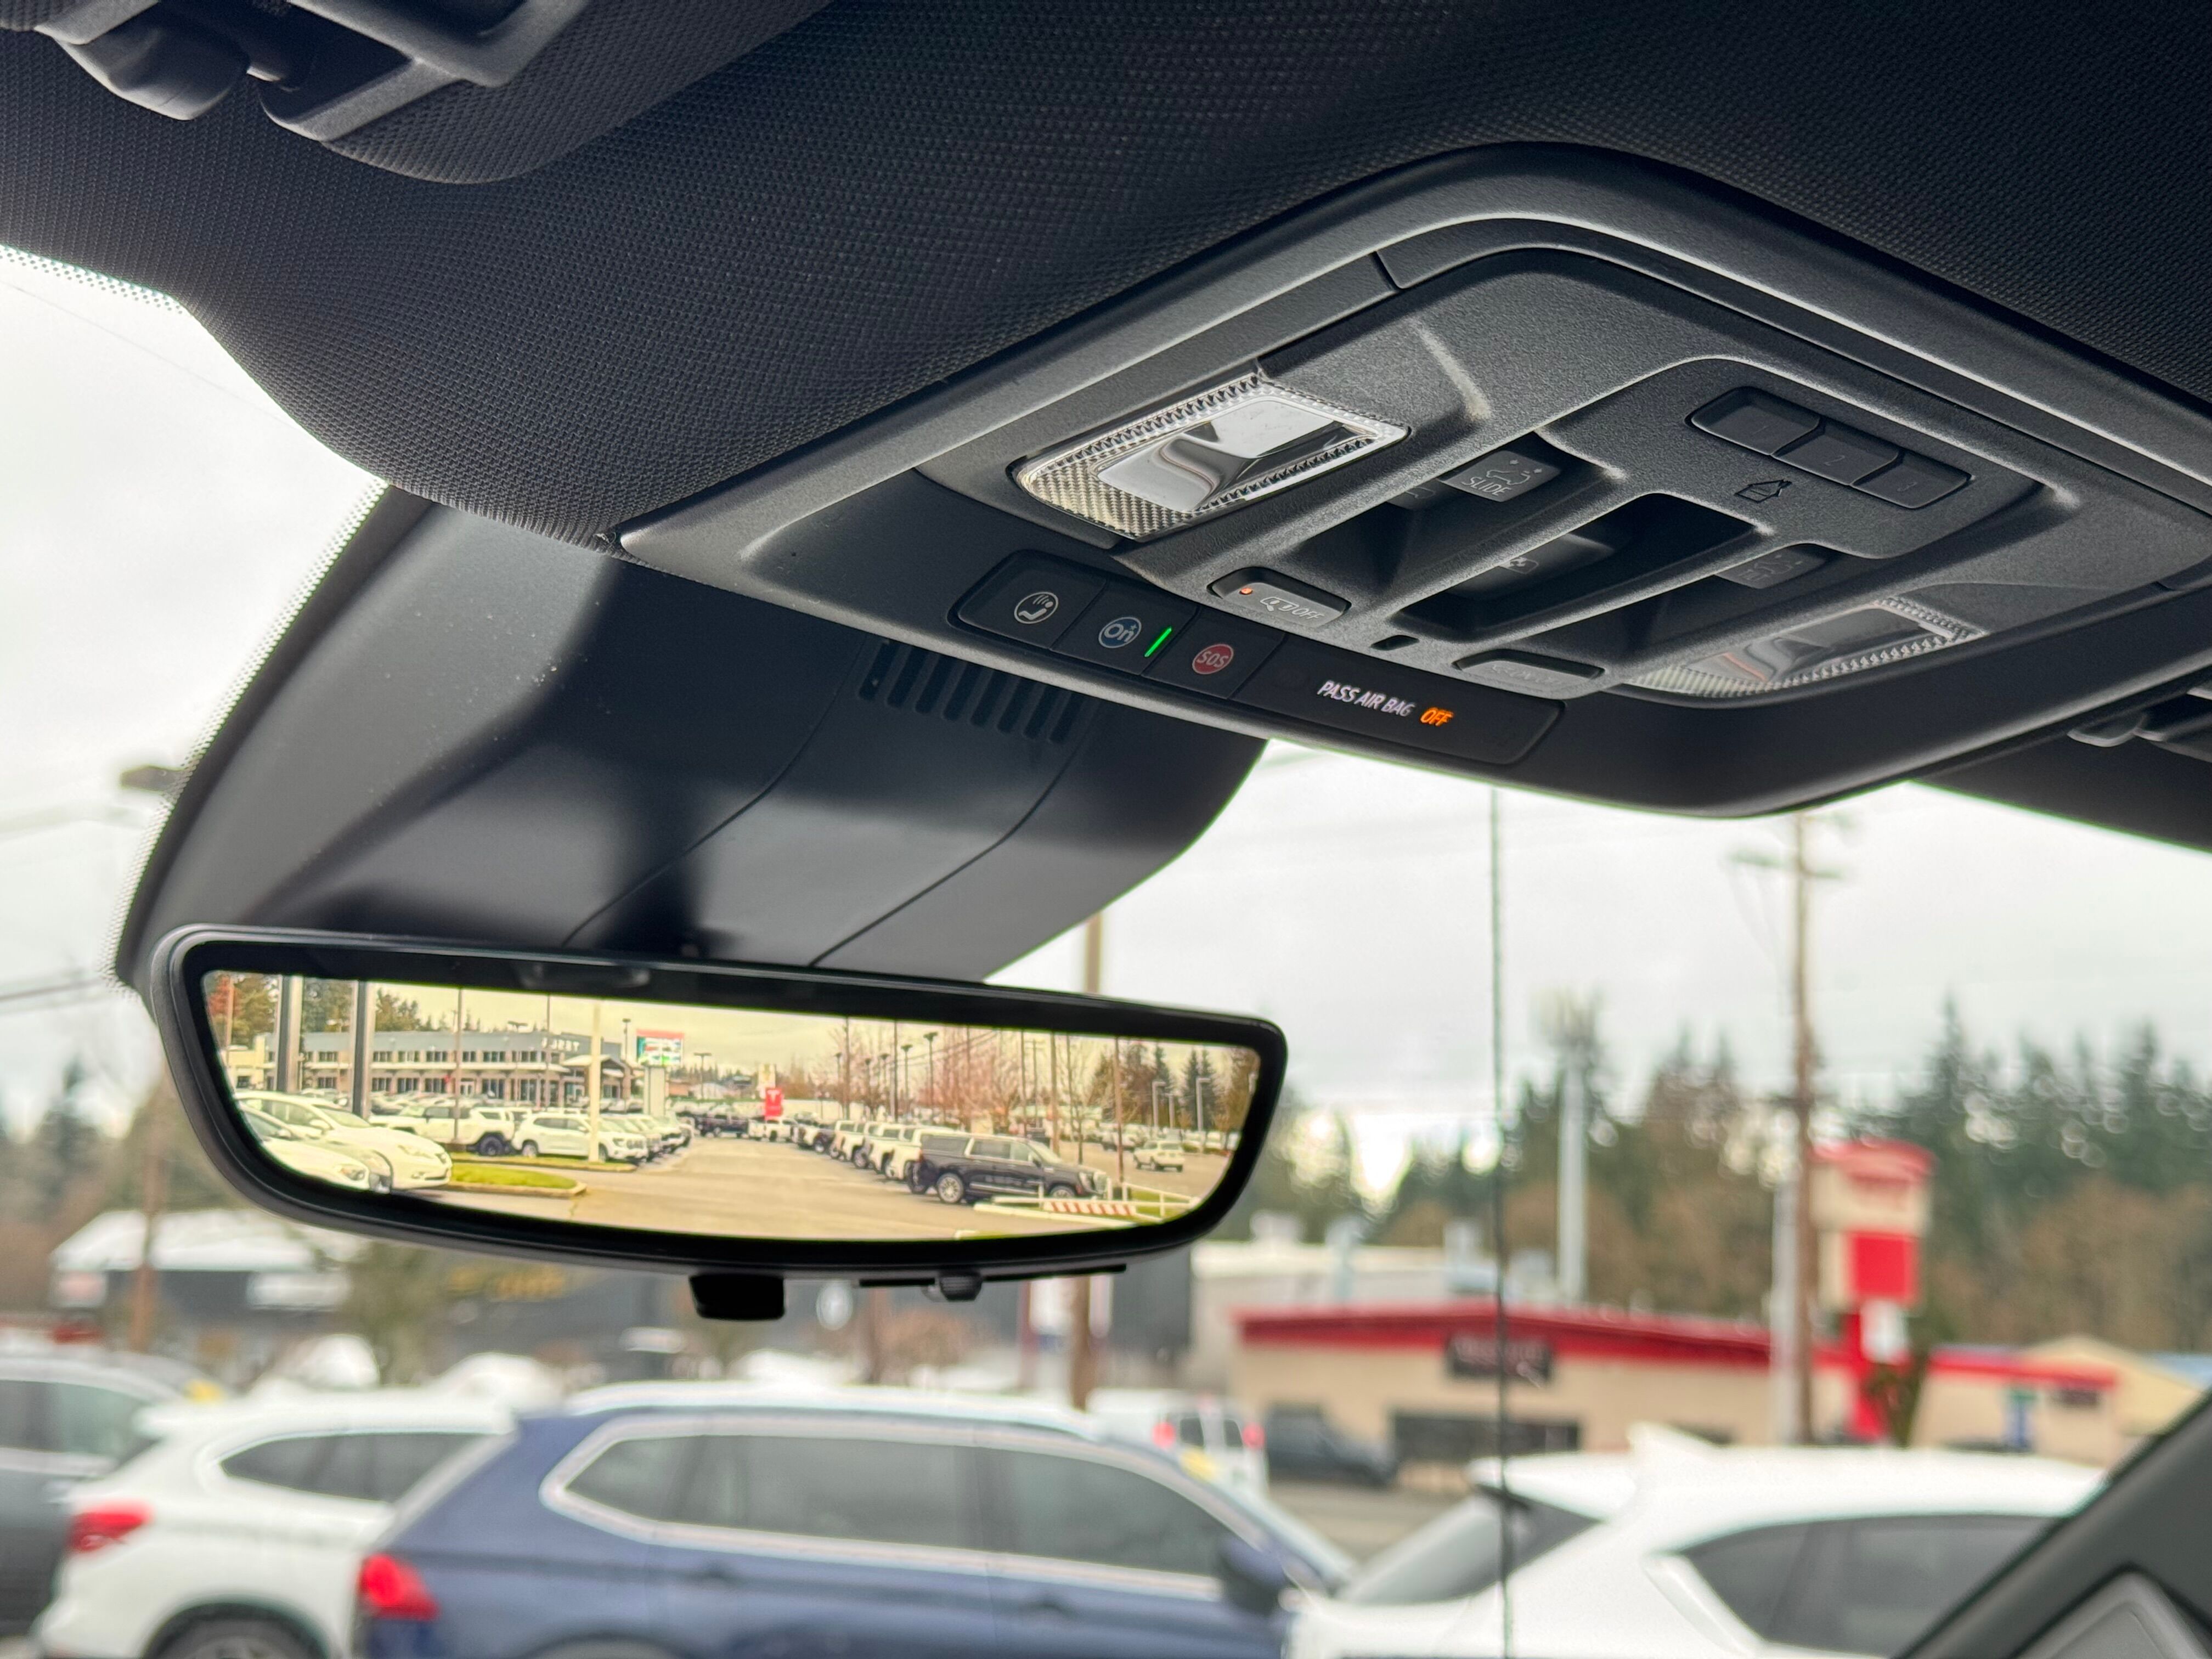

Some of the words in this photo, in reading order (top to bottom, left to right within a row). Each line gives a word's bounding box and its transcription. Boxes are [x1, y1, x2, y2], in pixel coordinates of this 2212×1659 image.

[1822, 455, 1846, 466] 2
[1462, 476, 1512, 496] SLIDE
[1897, 481, 1918, 493] 3
[1291, 608, 1325, 620] OFF
[1103, 623, 1135, 642] On
[1196, 650, 1228, 669] SOS
[1317, 680, 1361, 703] PASS
[1353, 691, 1386, 710] AIR
[1380, 697, 1416, 717] BAG
[1419, 707, 1454, 726] OFF
